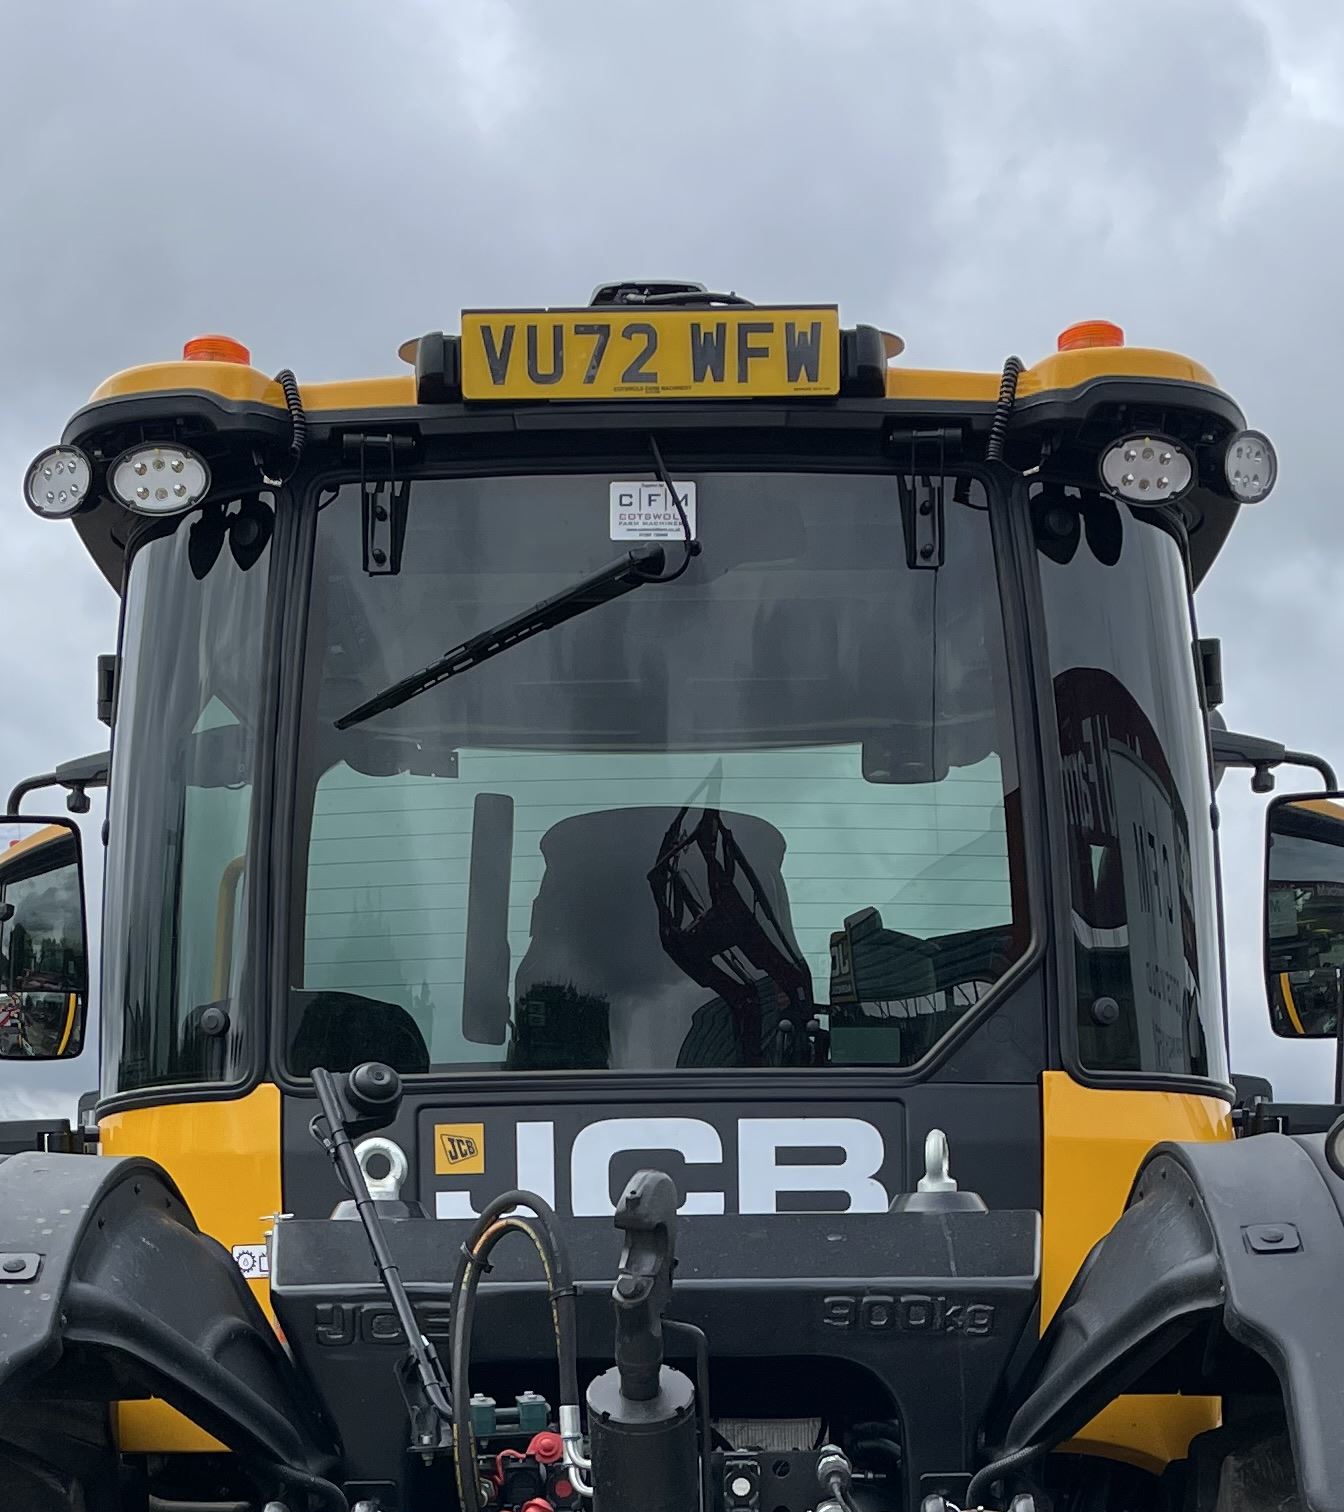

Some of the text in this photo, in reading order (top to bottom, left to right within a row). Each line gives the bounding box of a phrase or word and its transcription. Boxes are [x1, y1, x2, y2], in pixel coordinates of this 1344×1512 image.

[479, 321, 822, 386] VU72 WFW
[618, 513, 688, 521] COTSWOL
[435, 1116, 890, 1220] JCB
[447, 1136, 477, 1162] JCB
